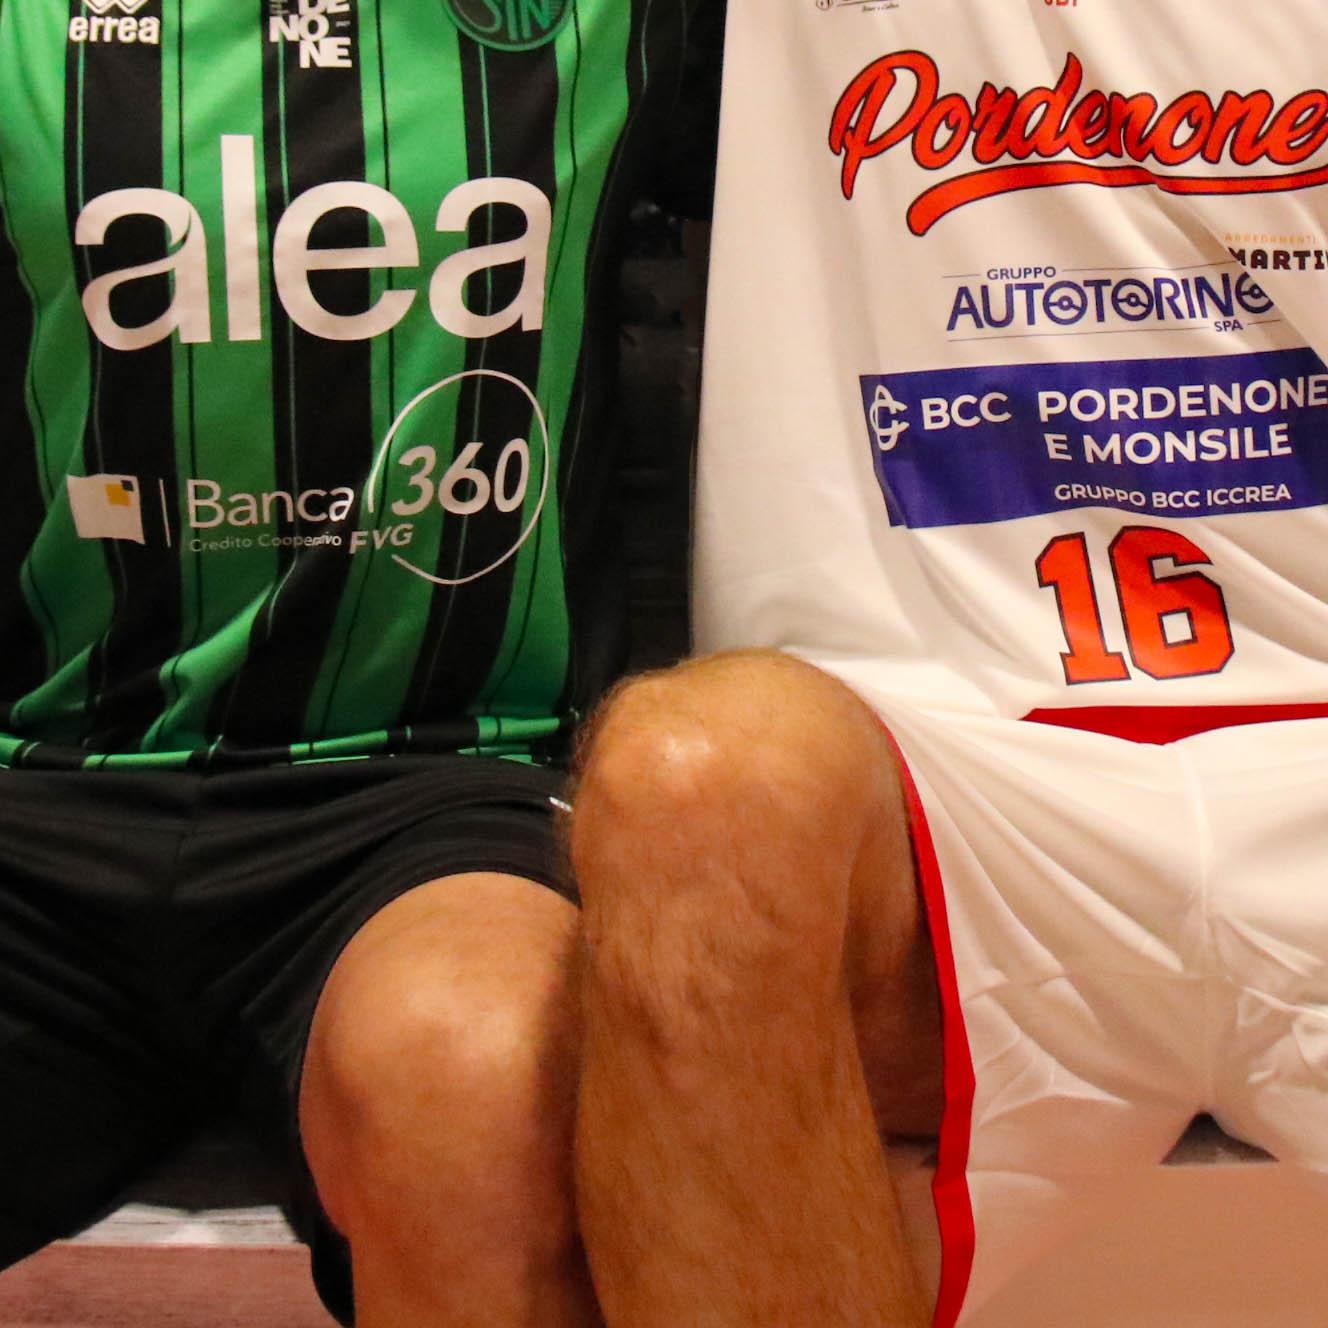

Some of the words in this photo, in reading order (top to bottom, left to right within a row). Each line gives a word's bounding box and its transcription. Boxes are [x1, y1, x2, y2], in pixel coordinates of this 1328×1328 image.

[69, 14, 161, 45] errea
[269, 13, 329, 43] NO
[299, 36, 352, 68] NE
[74, 134, 552, 351] alea
[986, 265, 1057, 281] GRUPPO
[1214, 319, 1244, 333] SPA
[921, 392, 1013, 431] BCC
[1043, 433, 1073, 462] E
[1083, 423, 1293, 465] MONSILE
[185, 477, 355, 529] Banca
[391, 438, 531, 516] 360
[1054, 484, 1146, 508] GRUPPO
[1153, 489, 1200, 509] BCC
[1206, 483, 1292, 507] ICCREA
[189, 535, 252, 553] Credito
[349, 523, 414, 555] FVG
[1035, 525, 1235, 685] 16
